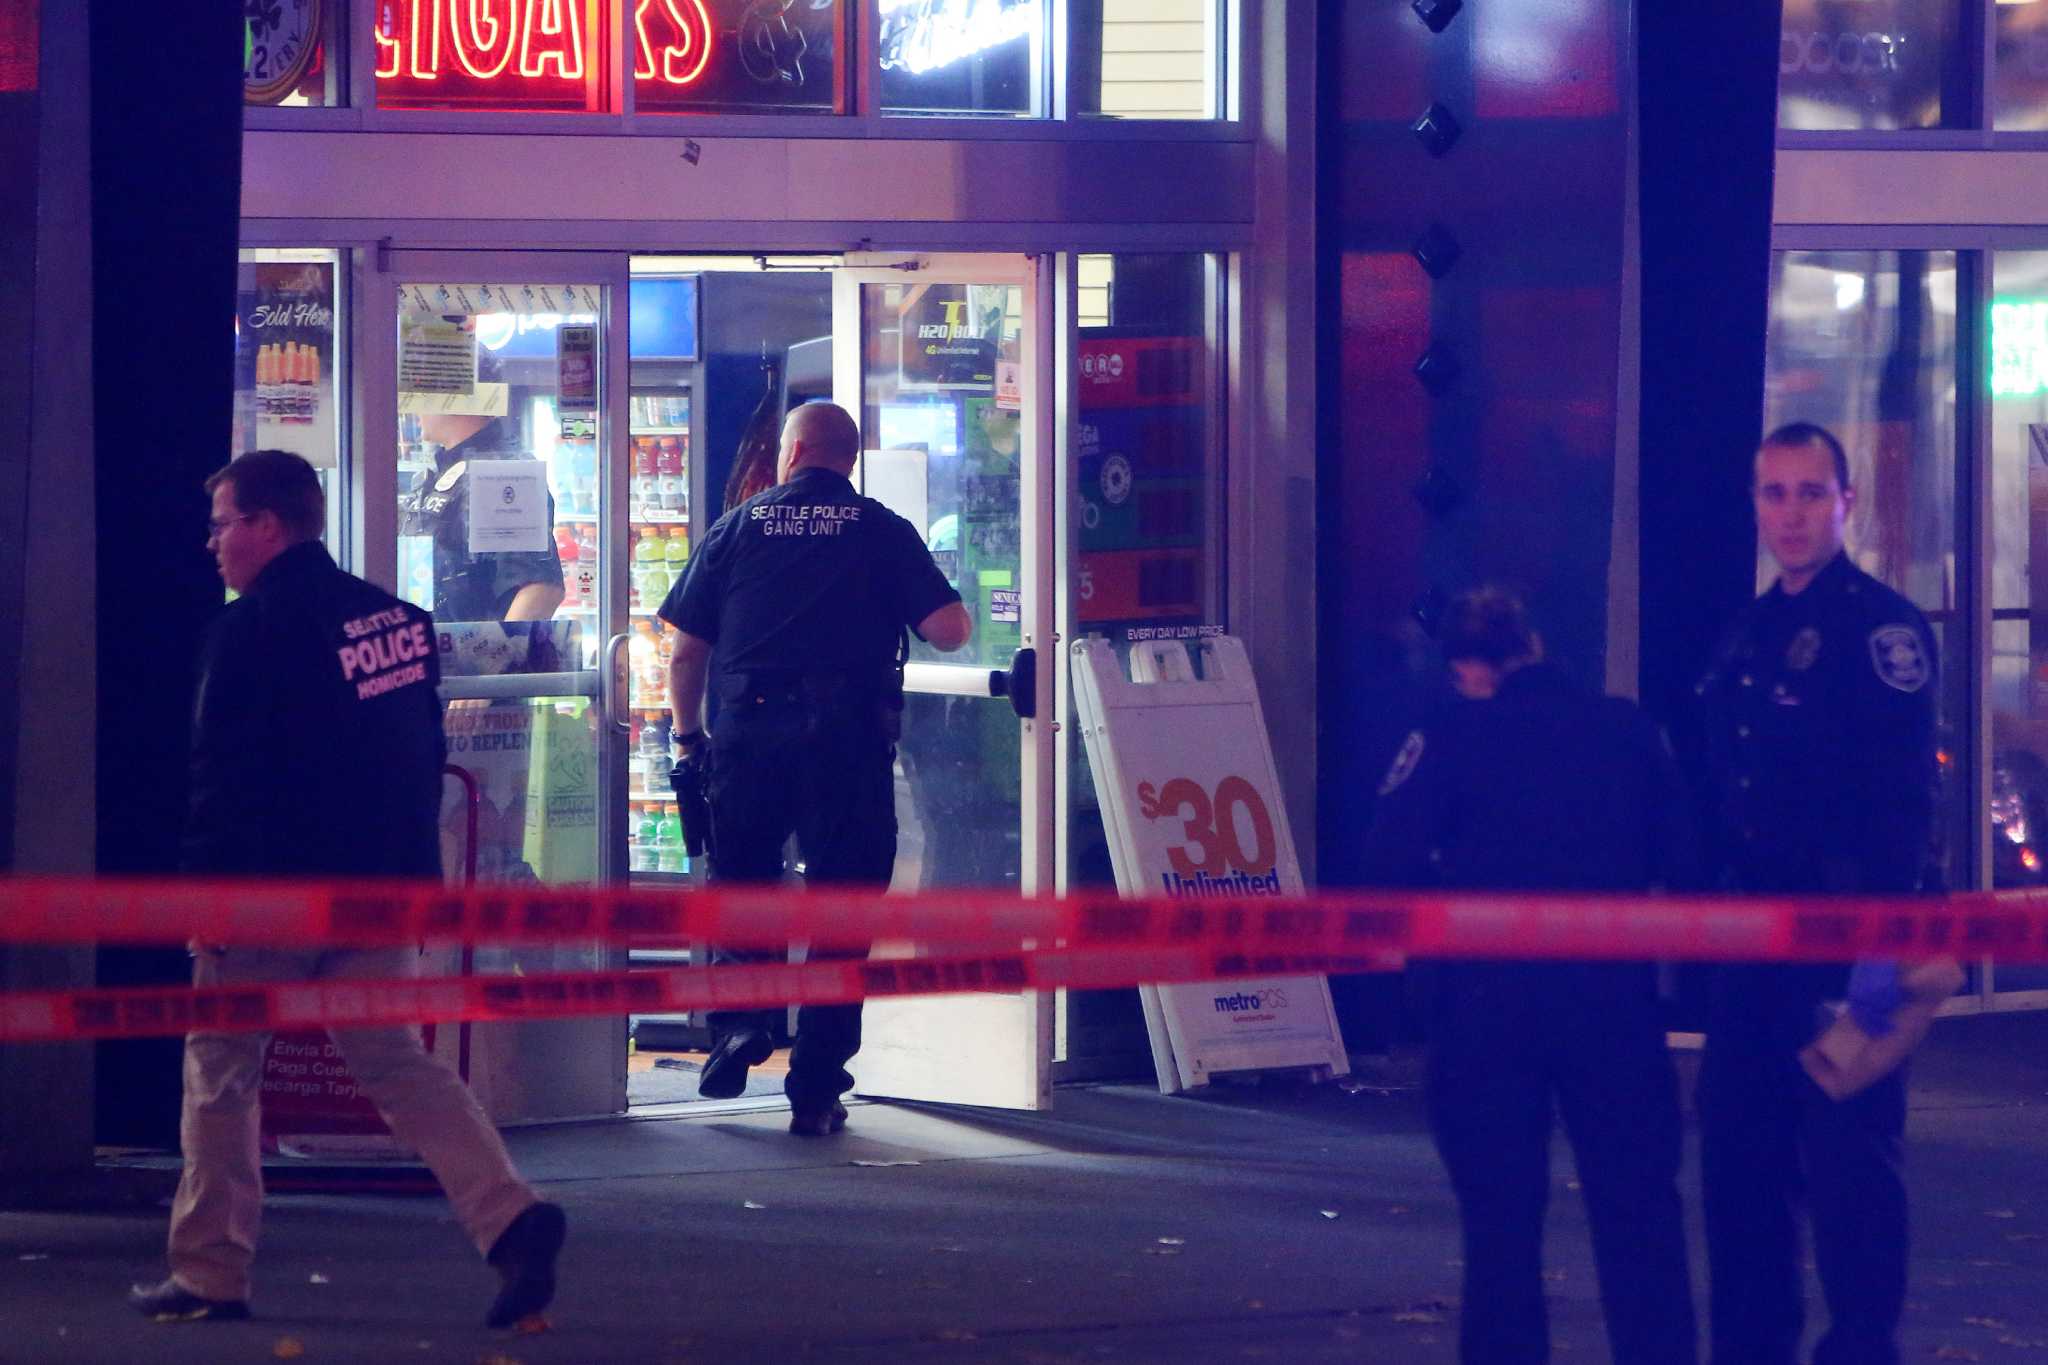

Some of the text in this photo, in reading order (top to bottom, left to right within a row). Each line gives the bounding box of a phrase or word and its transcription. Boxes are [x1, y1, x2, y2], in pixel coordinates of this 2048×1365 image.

[249, 304, 292, 328] Sold
[751, 505, 860, 520] SEATTLE POLICE
[763, 521, 843, 536] GANG UNIT
[343, 605, 408, 639] SEATTLE
[1127, 628, 1156, 640] EVERY
[1157, 627, 1176, 639] DAY
[1176, 626, 1200, 638] LOW
[338, 623, 430, 681] POLICE
[356, 662, 426, 700] HOMICIDE
[1137, 775, 1276, 877] $30
[1161, 867, 1281, 898] Unlimited
[1214, 987, 1289, 1012] metroPCS
[267, 1059, 307, 1077] Paga
